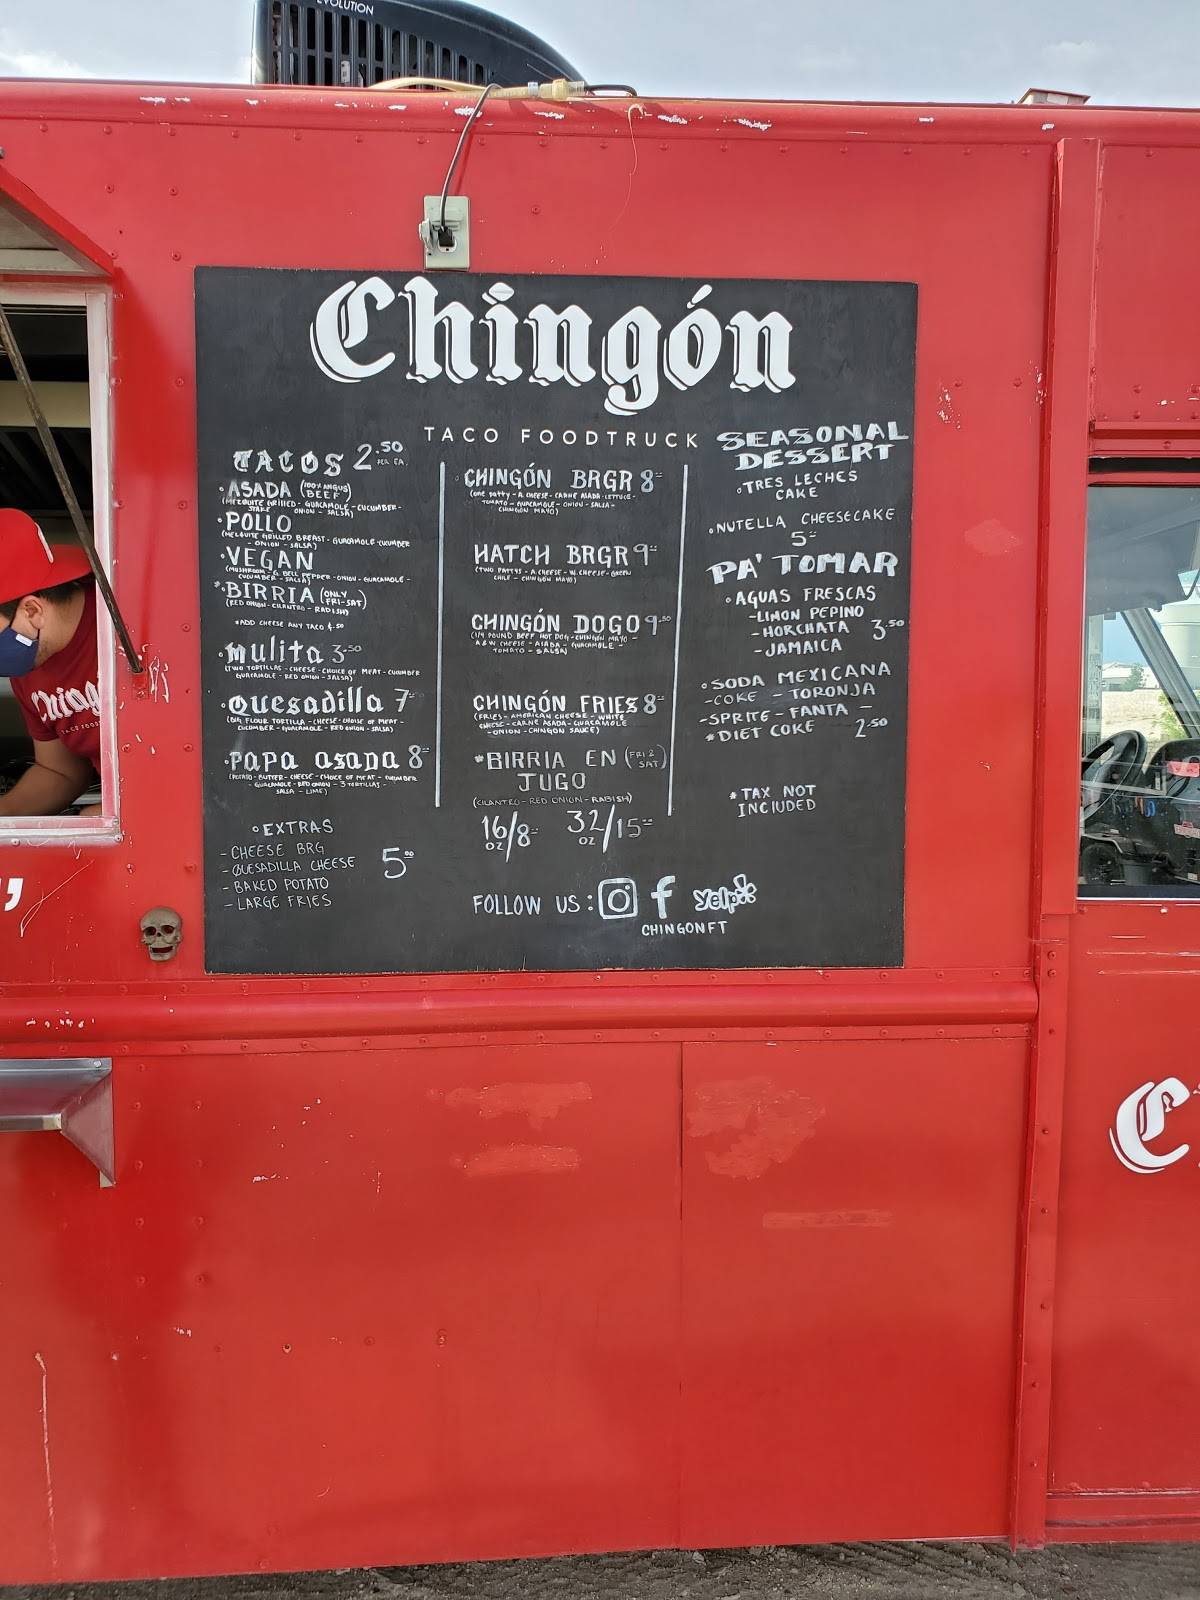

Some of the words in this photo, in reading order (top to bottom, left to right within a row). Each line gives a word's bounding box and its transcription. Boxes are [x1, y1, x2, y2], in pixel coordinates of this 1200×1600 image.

[310, 275, 797, 417] Chingón
[424, 426, 498, 443] TACO
[520, 428, 699, 449] FOODTRUCK
[716, 421, 909, 451] SEASONAL
[232, 449, 344, 477] TACOS
[734, 442, 895, 471] DESSERT
[464, 462, 551, 490] CHINGÓN
[570, 469, 633, 492] BRGR
[742, 476, 784, 494] TRES
[795, 470, 858, 487] LECHES
[226, 478, 292, 500] ASADA
[775, 486, 819, 501] CAKE
[225, 511, 292, 533] POLLO
[716, 514, 787, 534] NUTELLA
[801, 507, 896, 525] CHEESECAKE
[225, 546, 314, 571] VEGAN
[474, 543, 550, 566] HATCH
[566, 543, 629, 569] BRGR
[771, 551, 899, 577] TOMAR
[225, 581, 315, 604] BIRRIA
[735, 588, 791, 609] AGUAS
[804, 585, 876, 602] FRESCAS
[471, 607, 560, 633] CHINGÓN
[572, 614, 640, 635] DOGO
[756, 609, 800, 623] LIMON
[810, 605, 865, 620] PEPINO
[762, 620, 850, 639] HORCHATA
[765, 638, 843, 657] JAMAICA
[711, 675, 766, 690] SODA
[777, 662, 892, 685] MEXICANA
[228, 686, 384, 717] Quesadilla
[473, 689, 566, 713] CHINGÓN
[580, 695, 639, 714] FRIES
[714, 690, 759, 706] COKE
[788, 682, 876, 700] TORONJA
[708, 709, 771, 725] SPRITE
[788, 703, 849, 719] FANTA
[717, 727, 763, 742] DIET
[770, 719, 815, 737] COKE
[487, 751, 566, 770] BIRRIA
[585, 749, 617, 767] EN
[517, 772, 587, 792] JUGO
[741, 786, 771, 801] TAX
[783, 784, 817, 798] NOT
[529, 797, 548, 805] RED
[551, 796, 583, 804] ONION
[737, 799, 817, 818] INCLUDED
[263, 819, 334, 837] EXTRAS
[231, 843, 284, 860] CHEESE
[296, 841, 325, 856] BRG
[232, 860, 302, 878] QUESADILLA
[310, 856, 356, 872] CHEESE
[234, 878, 277, 894] BAKED
[284, 876, 329, 891] POTATO
[237, 895, 280, 911] LARGE
[288, 893, 332, 908] FRIES
[472, 894, 541, 916] FOLLOW
[641, 920, 728, 936] CHINGONFT
